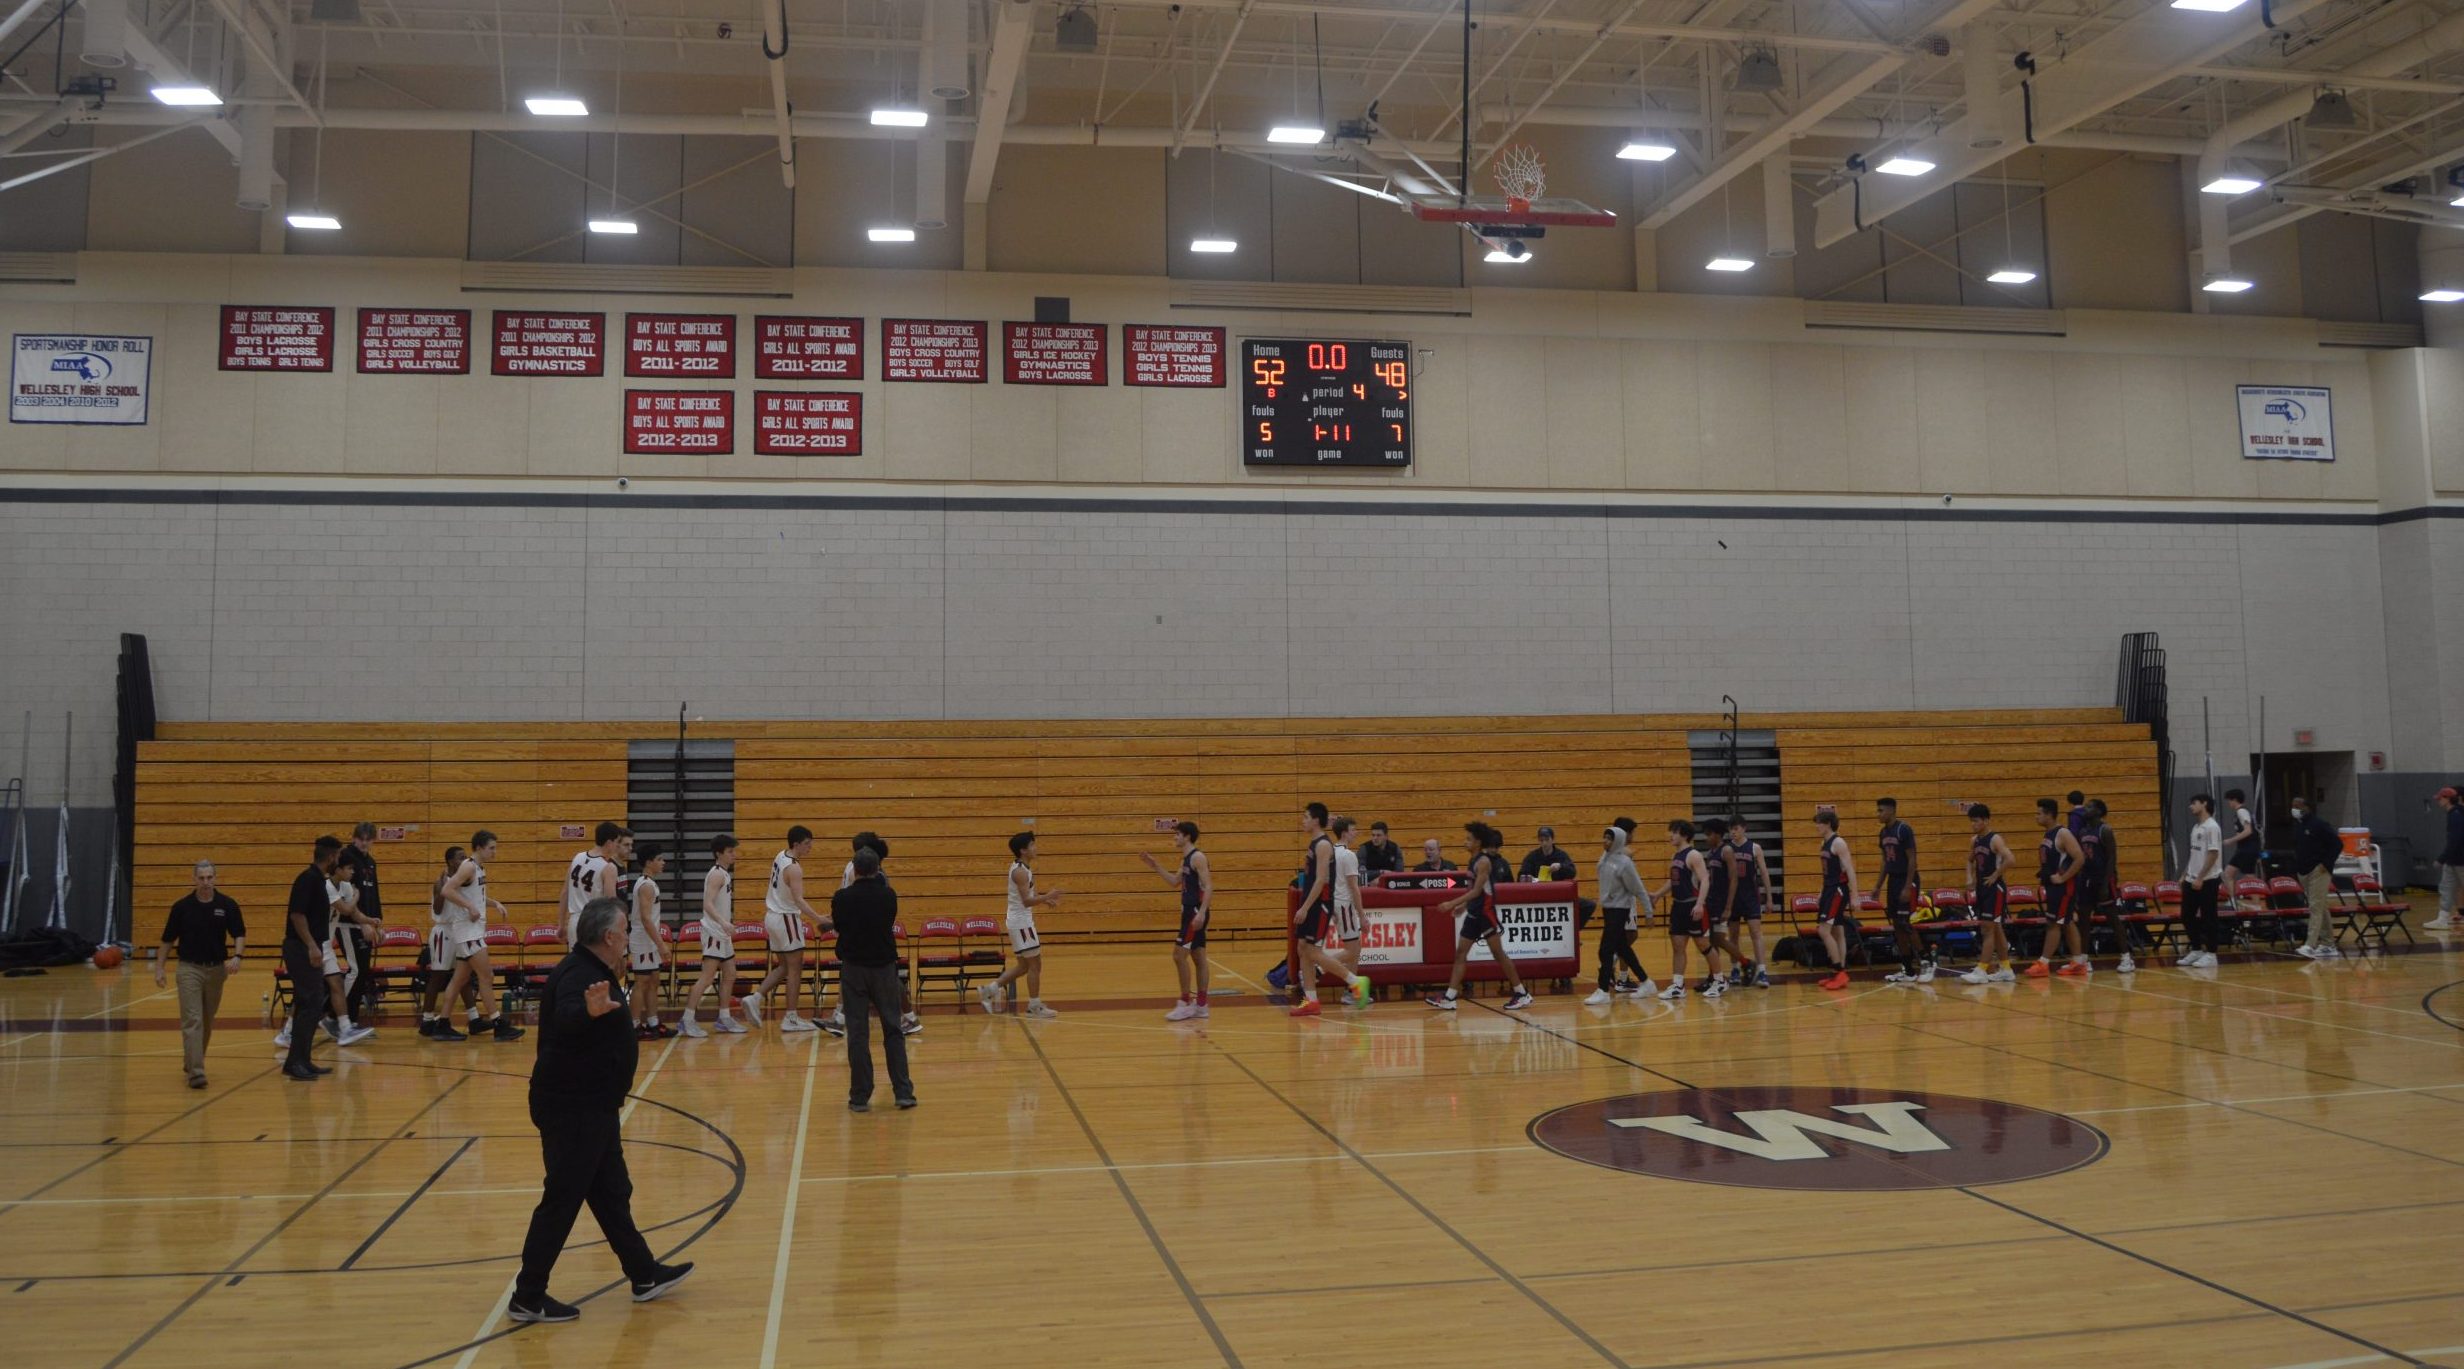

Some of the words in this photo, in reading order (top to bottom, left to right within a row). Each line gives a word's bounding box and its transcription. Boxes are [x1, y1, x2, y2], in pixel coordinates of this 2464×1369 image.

[235, 311, 249, 321] BAY
[252, 312, 272, 322] STATE
[276, 313, 320, 322] CONFERENCE
[372, 314, 385, 324] BAY
[389, 314, 410, 324] STATE
[414, 315, 456, 325] CONFERENCE
[230, 324, 246, 334] 2011
[251, 324, 302, 334] CHAMPIONSHIPS
[307, 325, 324, 334] 2012
[507, 318, 520, 328] BAY
[524, 319, 544, 328] STATE
[549, 319, 590, 329] CONFERENCE
[637, 322, 651, 333] BAY
[655, 322, 676, 334] STATE
[681, 323, 722, 335] CONFERENCE
[366, 327, 382, 336] 2011
[388, 327, 439, 337] CHAMPIONSHIPS
[445, 327, 461, 337] 2012
[768, 325, 780, 336] BAY
[785, 325, 805, 336] STATE
[810, 326, 850, 338] CONFERENCE
[894, 325, 907, 334] BAY
[910, 325, 930, 335] STATE
[934, 326, 974, 335] CONFERENCE
[1016, 327, 1028, 337] BAY
[1032, 328, 1052, 337] STATE
[1056, 328, 1094, 338] CONFERENCE
[1136, 330, 1148, 339] BAY
[1152, 331, 1171, 340] STATE
[1175, 332, 1213, 341] CONFERENCE
[501, 332, 516, 342] 2011
[523, 332, 574, 342] CHAMPIONSHIPS
[579, 333, 595, 343] 2012
[891, 337, 906, 346] 2012
[911, 337, 959, 347] CHAMPIONSHIPS
[963, 338, 978, 347] 2013
[20, 339, 87, 351] SPORTSMANSHIP
[92, 340, 118, 352] HONOR
[123, 341, 144, 352] ROLL
[633, 339, 652, 351] BOYS
[656, 340, 670, 352] ALL
[675, 340, 700, 352] SPORTS
[706, 341, 727, 352] AWARD
[764, 342, 782, 354] GIRLS
[787, 343, 800, 354] ALL
[805, 343, 830, 354] SPORTS
[835, 344, 856, 355] AWARD
[1012, 339, 1027, 348] 2012
[1032, 339, 1079, 349] CHAMPIONSHIPS
[1083, 341, 1098, 350] 2013
[1132, 342, 1147, 351] 2012
[1151, 342, 1198, 352] CHAMPIONSHIPS
[1202, 344, 1217, 353] 2013
[235, 347, 263, 355] GIRLS
[268, 347, 318, 356] LACROSSE
[500, 346, 528, 356] GIRLS
[533, 346, 595, 356] BASKETBALL
[1253, 345, 1280, 356] Home
[1371, 347, 1403, 359] Guests
[1172, 354, 1211, 362] TENNIS
[1308, 344, 1347, 370] 0.0
[509, 360, 586, 370] GYMNASTICS
[772, 359, 847, 372] 2011-2012
[1136, 364, 1168, 372] GIRLS
[1173, 364, 1212, 372] TENNIS
[1254, 359, 1285, 385] 52
[1375, 362, 1405, 387] 48
[1167, 374, 1212, 382] LACROSSE
[20, 384, 76, 395] WELLESLEY
[80, 386, 100, 395] HIGH
[106, 386, 140, 396] SCHOOL
[1313, 387, 1343, 398] period
[1353, 384, 1364, 400] 4
[70, 398, 91, 406] 2010
[96, 398, 117, 406] 2012
[638, 398, 651, 410] BAY
[656, 398, 676, 410] STATE
[680, 398, 720, 410] CONFERENCE
[768, 399, 780, 410] BAY
[784, 399, 804, 411] STATE
[809, 400, 849, 412] CONFERENCE
[1252, 405, 1274, 416] fouls
[1313, 406, 1343, 417] player
[1382, 407, 1404, 418] fouls
[633, 416, 652, 428] BOYS
[656, 416, 669, 428] ALL
[674, 416, 699, 428] SPORTS
[703, 416, 724, 428] AWARD
[763, 417, 781, 428] GIRLS
[785, 417, 798, 429] ALL
[803, 418, 828, 429] SPORTS
[832, 418, 853, 429] AWARD
[1260, 422, 1272, 441] 5
[1391, 424, 1401, 442] 7
[638, 434, 717, 446] 2012-2013
[770, 435, 846, 447] 2012-2013
[1318, 450, 1342, 460] game
[1385, 451, 1403, 459] won
[571, 864, 595, 892] 44
[1428, 880, 1447, 888] POSS
[1501, 907, 1569, 923] RAIDER
[1509, 926, 1562, 942] PRIDE
